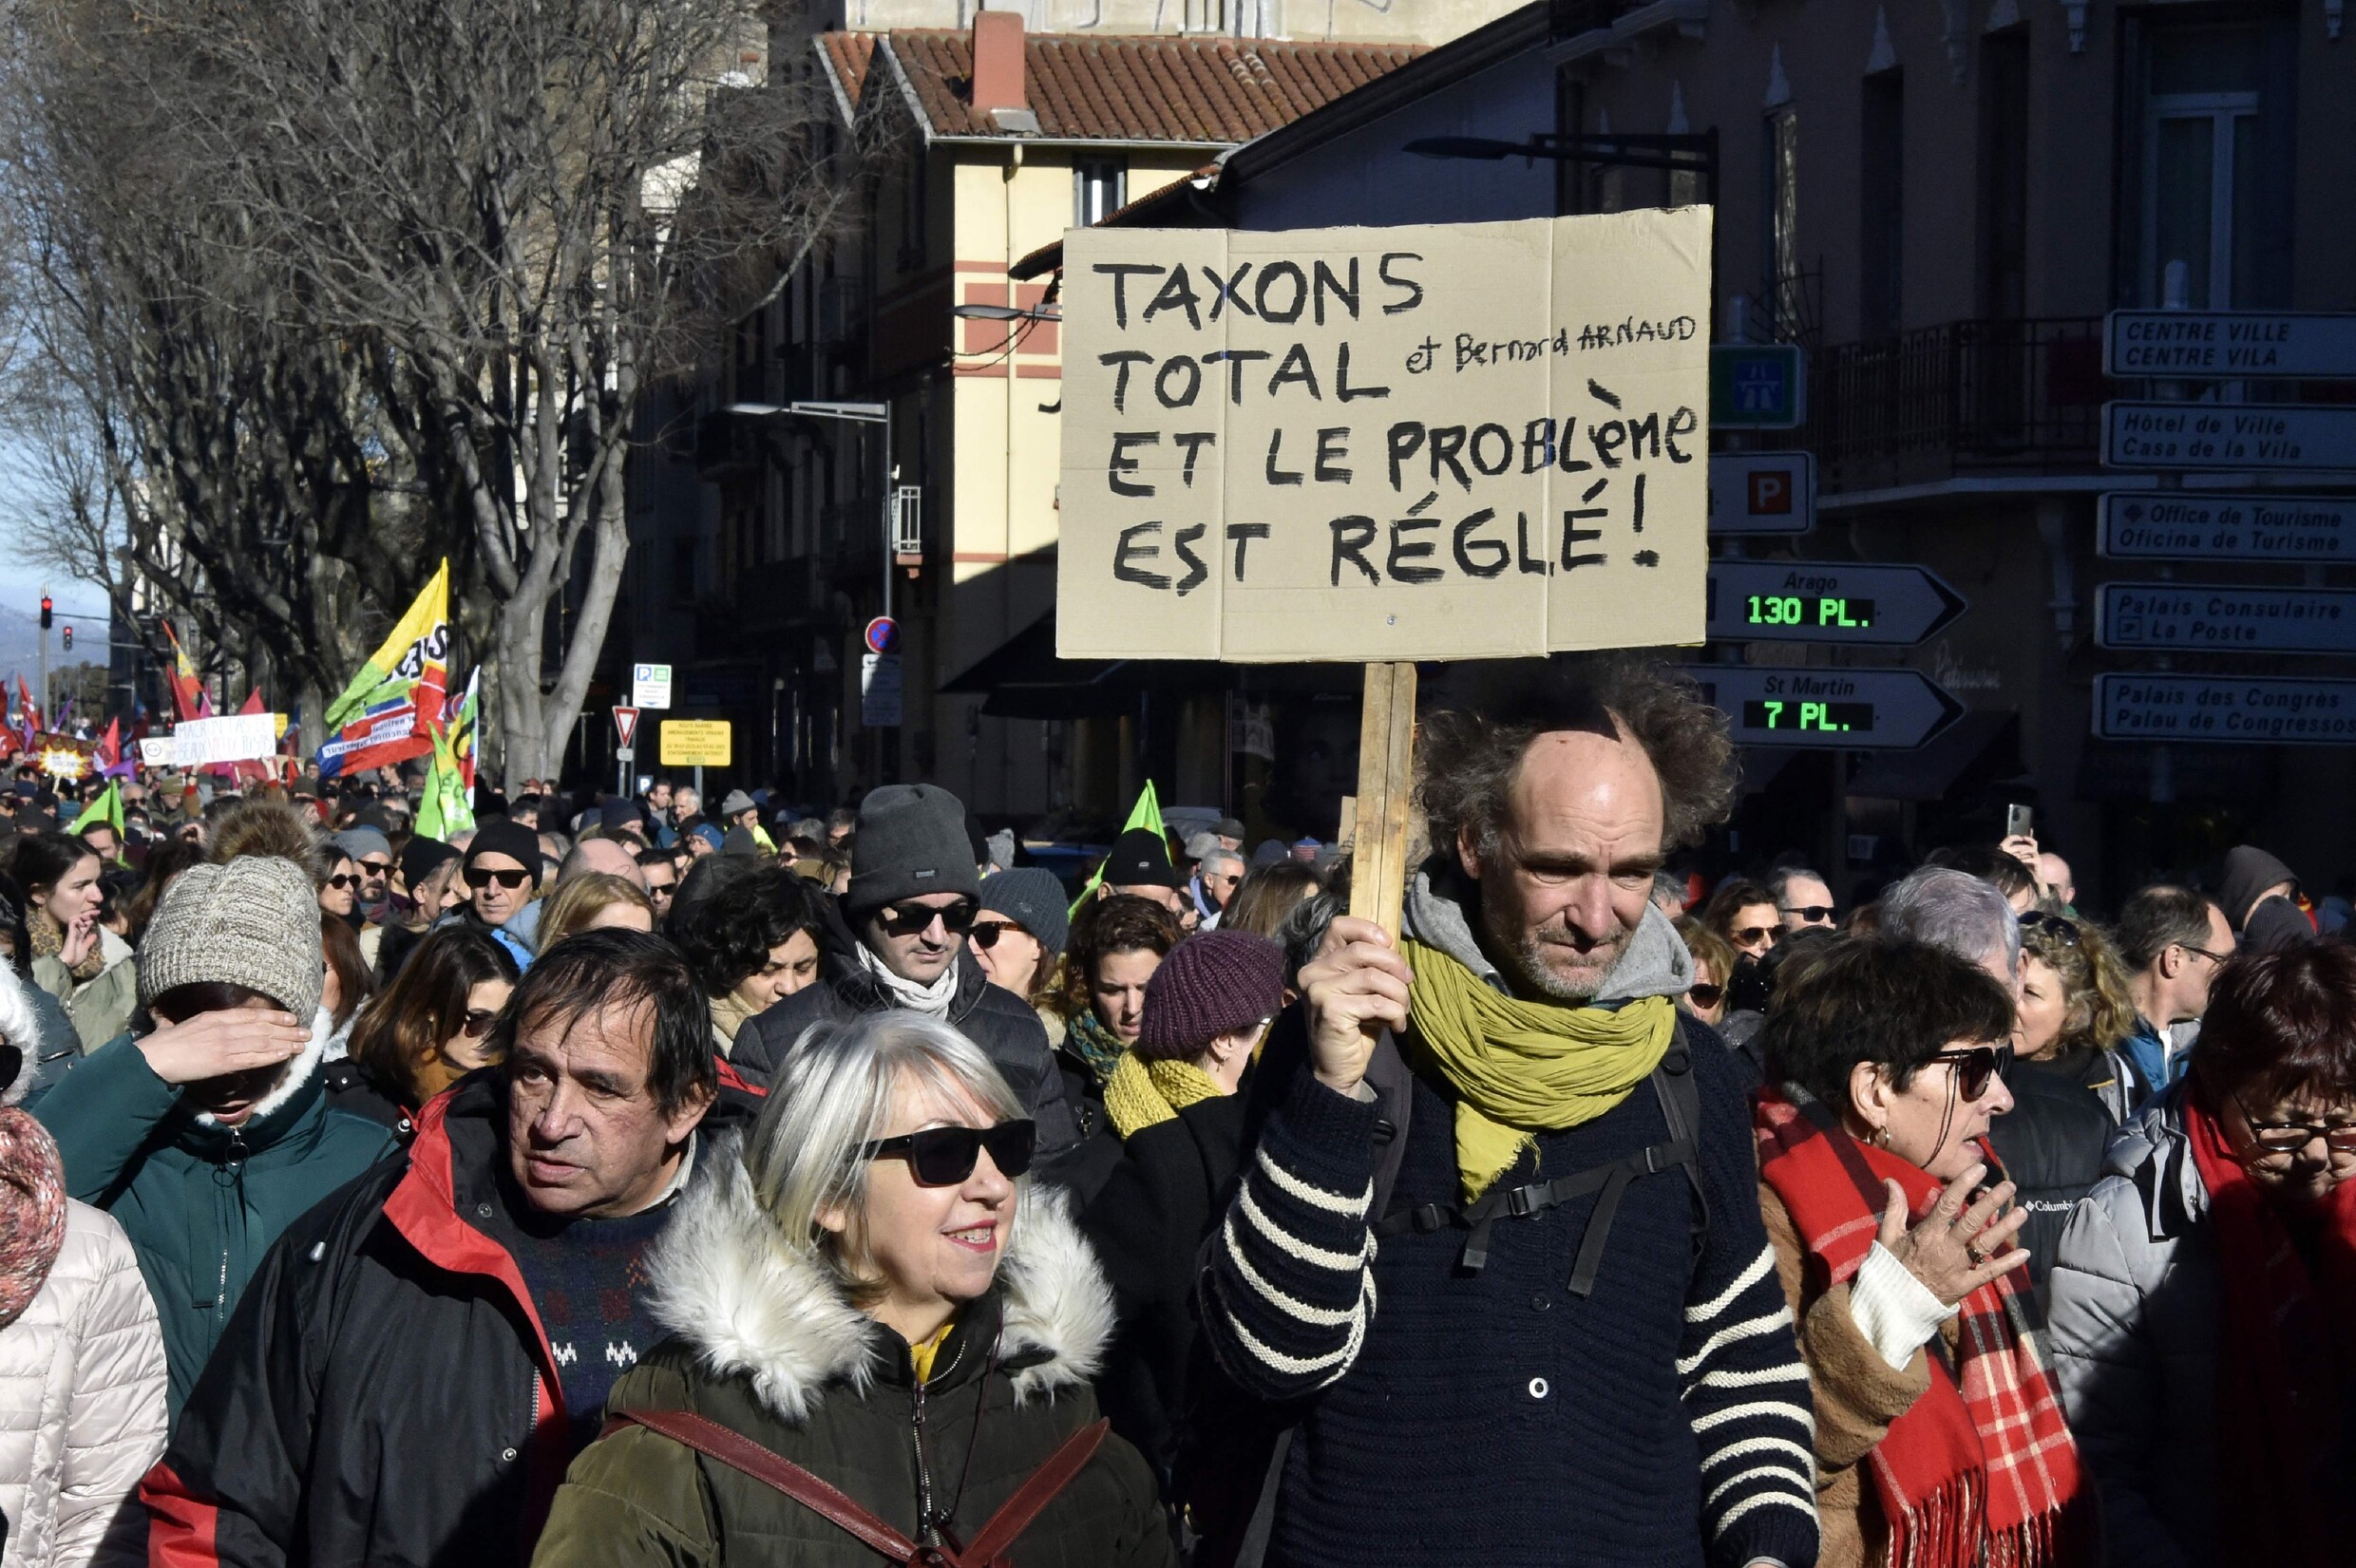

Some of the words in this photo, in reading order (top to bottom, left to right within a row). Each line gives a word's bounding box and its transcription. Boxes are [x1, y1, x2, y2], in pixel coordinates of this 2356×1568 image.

[1092, 252, 1424, 331] TAXONS
[1405, 335, 1442, 374] et
[1454, 332, 1569, 373] Bernard
[1576, 315, 1697, 352] ARNAUD
[2126, 322, 2217, 342] CENTRE
[2229, 323, 2291, 343] VILLE
[2125, 346, 2215, 367] CENTRE
[2227, 348, 2278, 367] VILA
[1098, 341, 1391, 414] TOTAL
[2123, 412, 2186, 433] Hôtel
[2195, 415, 2222, 434] de
[2234, 415, 2287, 435] Ville
[2122, 437, 2177, 458] Casa
[2188, 439, 2214, 458] de
[2225, 440, 2245, 458] la
[2257, 441, 2301, 460] Vila
[1109, 431, 1217, 498] ET
[1265, 427, 1354, 486] LE
[2150, 504, 2211, 524] Office
[2217, 506, 2243, 525] de
[2252, 506, 2343, 529] Tourisme
[2118, 528, 2201, 549] Oficina
[2212, 531, 2238, 550] de
[2251, 531, 2341, 552] Turisme
[1113, 520, 1271, 597] EST
[1782, 572, 1839, 595] Arago
[1748, 595, 1802, 625] 130
[1818, 598, 1870, 628] PL.
[2117, 595, 2193, 616] Palais
[2207, 597, 2343, 619] Consulaire
[2151, 620, 2177, 640] La
[2190, 620, 2258, 641] Poste
[1764, 675, 1786, 695] St
[1792, 676, 1856, 696] Martin
[2116, 685, 2185, 706] Palais
[2195, 687, 2235, 707] des
[2245, 688, 2341, 712] Congrès
[1764, 701, 1783, 728] 7
[1799, 702, 1851, 731] PL.
[2115, 708, 2178, 729] Palau
[2188, 711, 2215, 730] de
[2225, 711, 2356, 737] Congressos
[2035, 1200, 2074, 1212] Columbi
